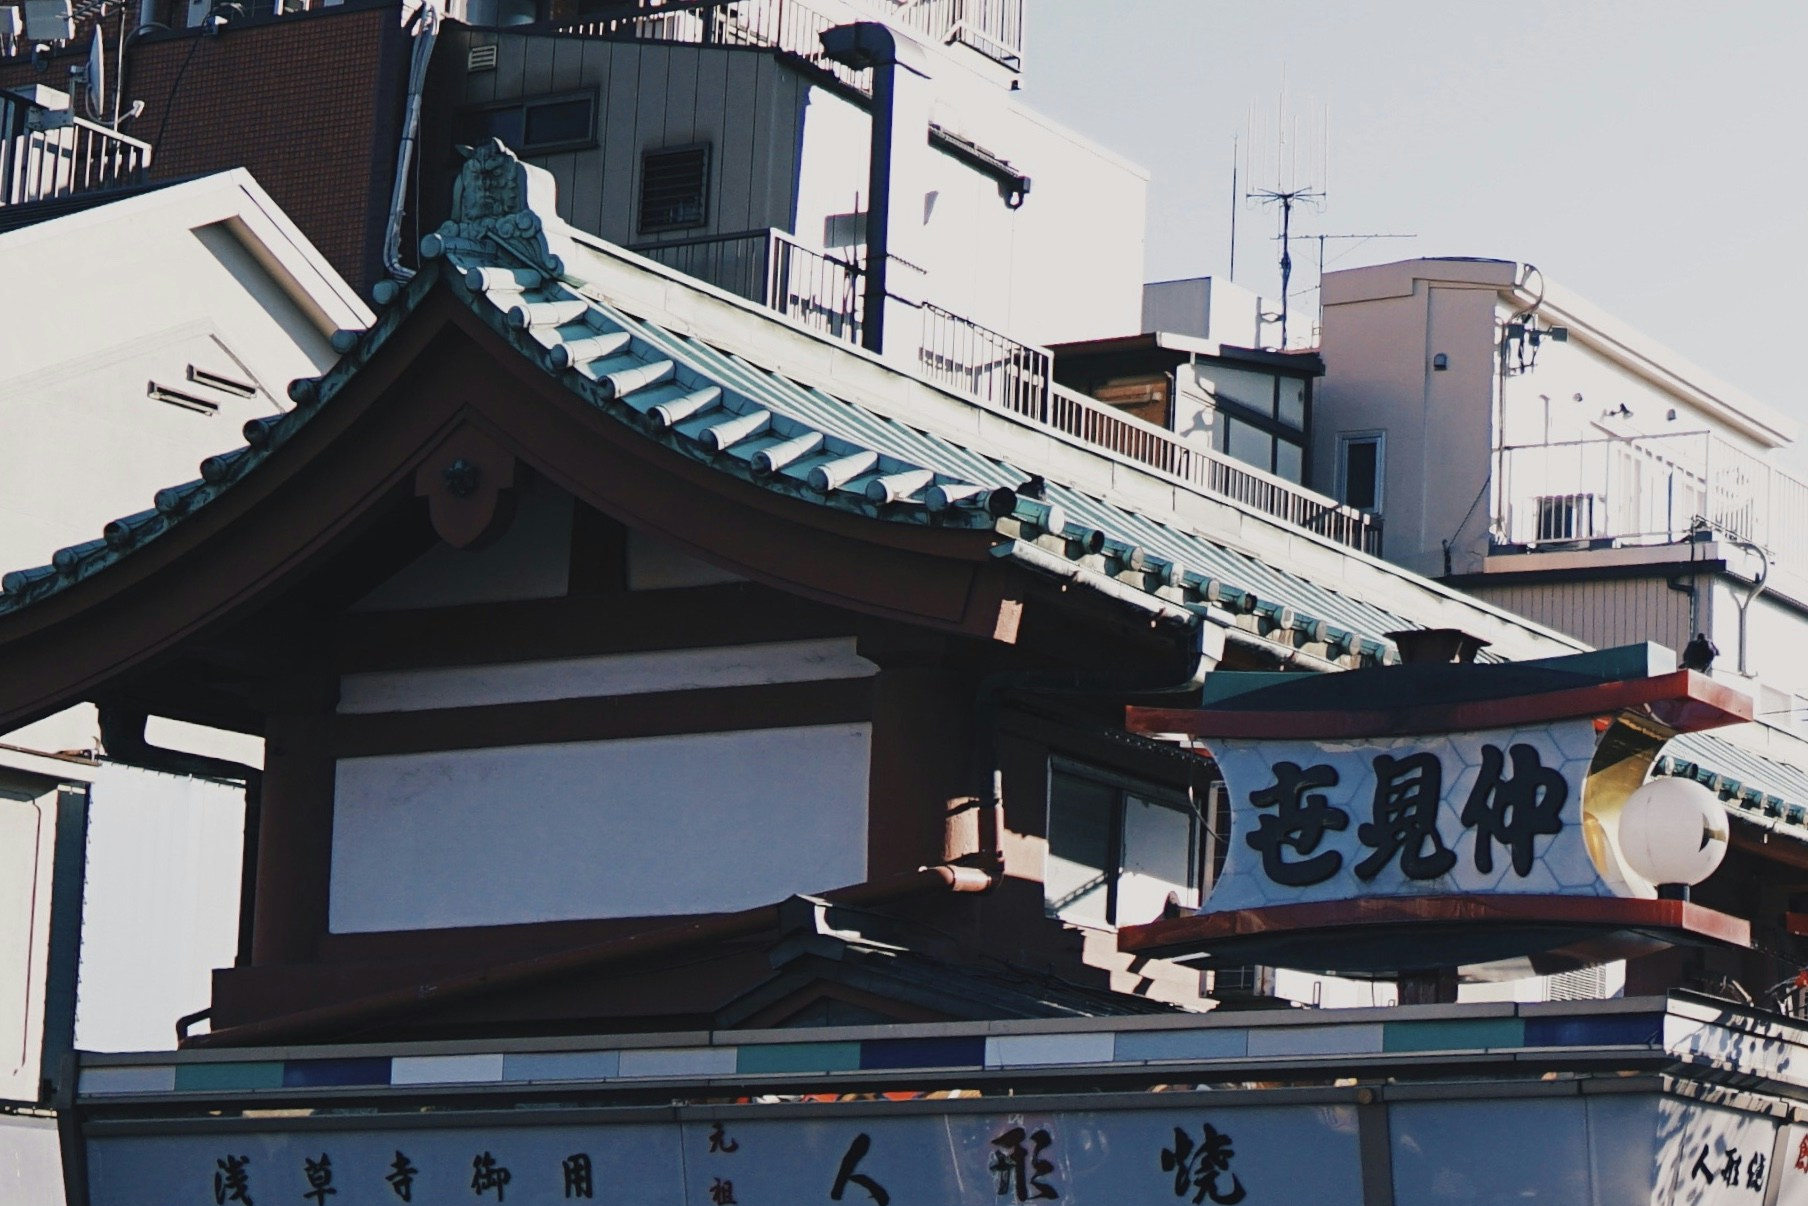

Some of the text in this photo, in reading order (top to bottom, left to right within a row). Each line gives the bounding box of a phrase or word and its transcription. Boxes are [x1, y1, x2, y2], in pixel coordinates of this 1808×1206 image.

[708, 1122, 739, 1206] 元祖
[829, 1122, 1248, 1206] 人形焼
[1690, 1142, 1768, 1194] 人形焼
